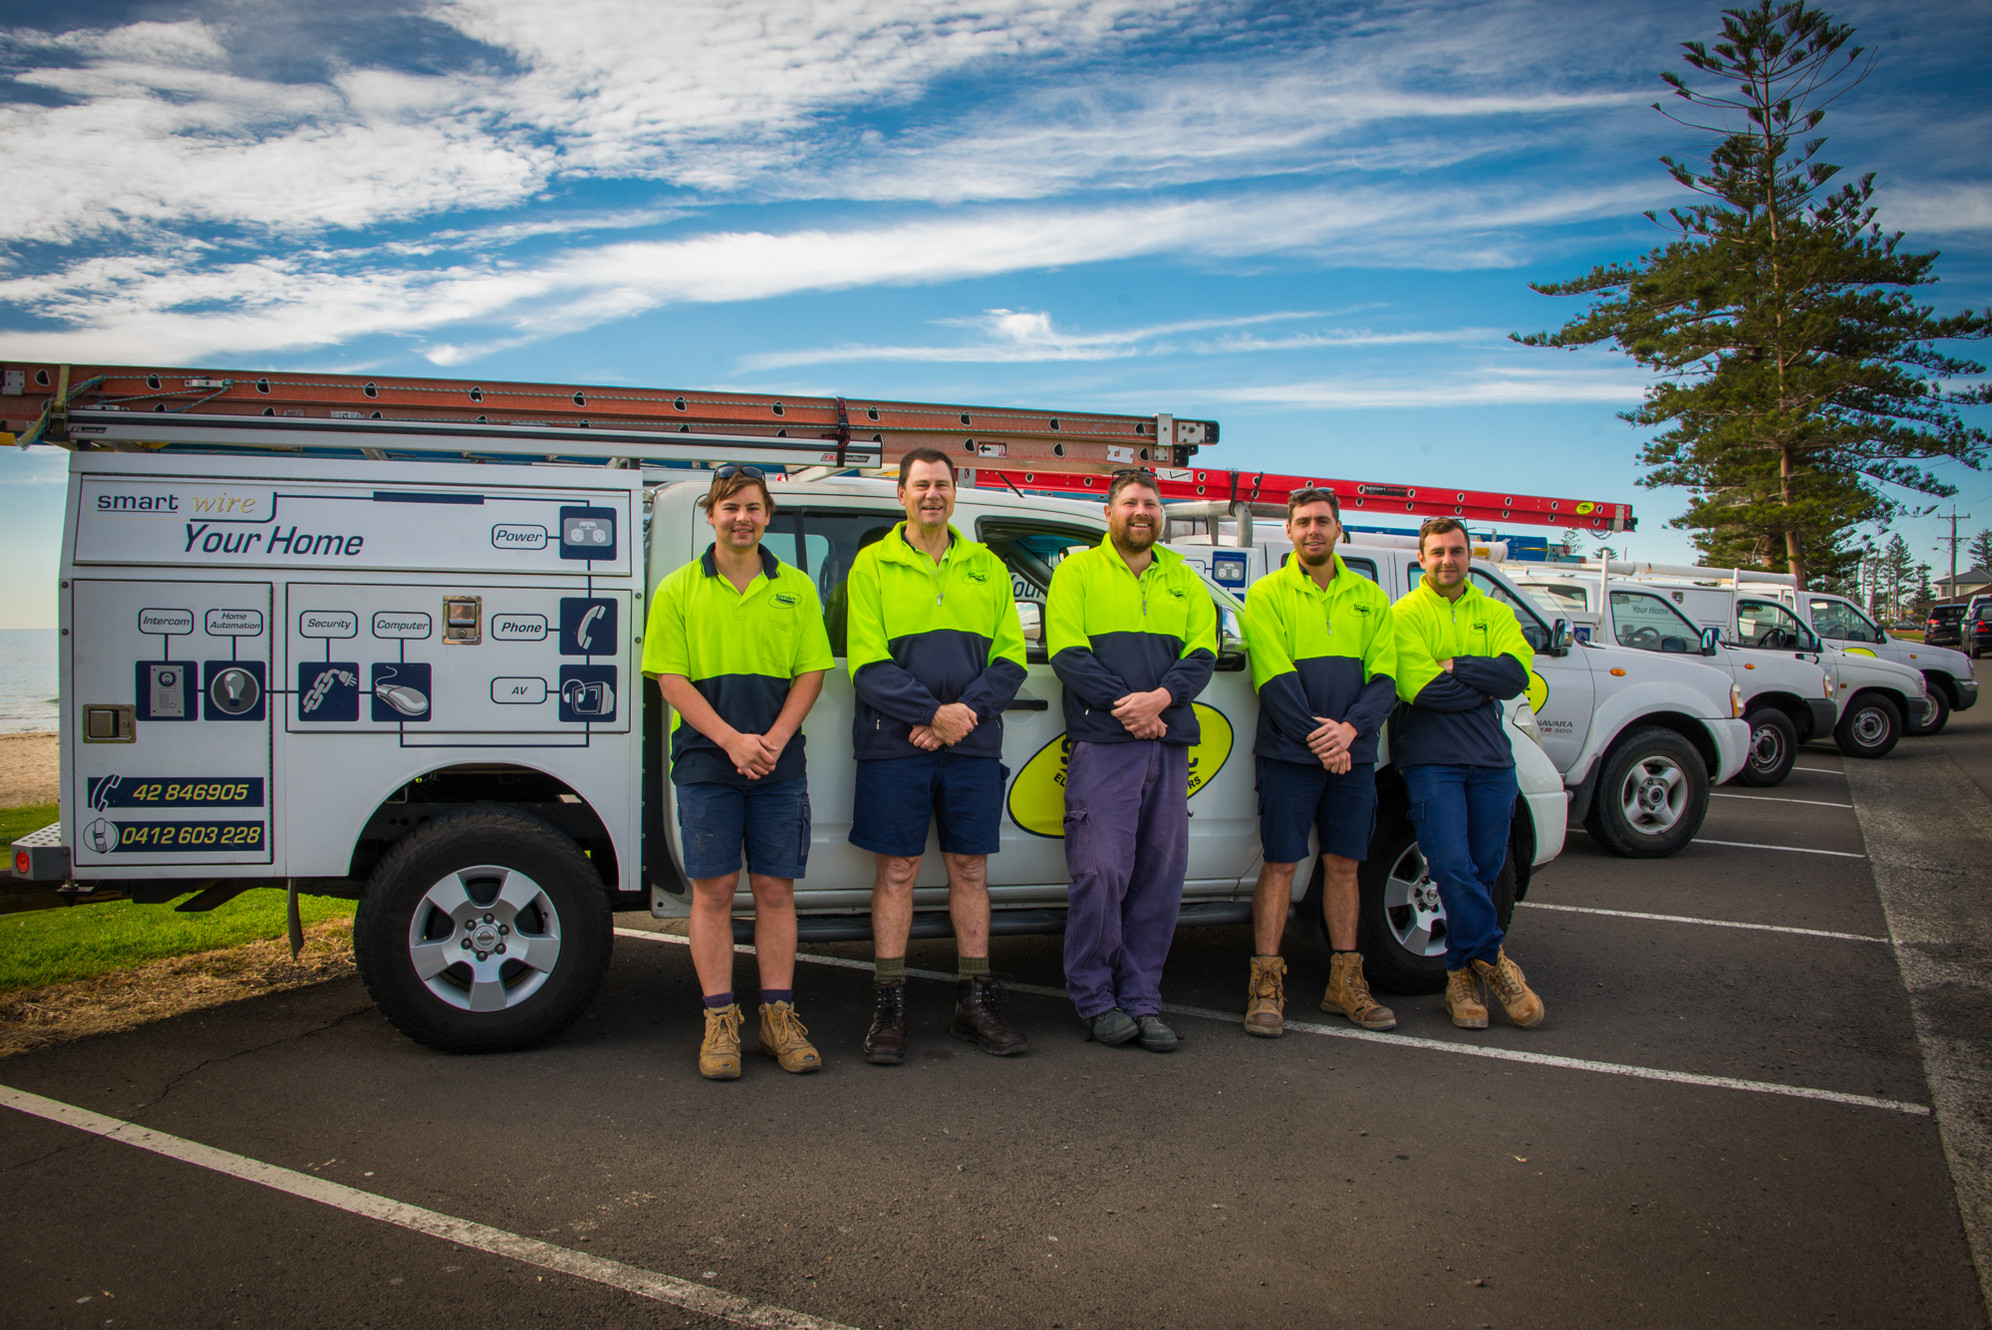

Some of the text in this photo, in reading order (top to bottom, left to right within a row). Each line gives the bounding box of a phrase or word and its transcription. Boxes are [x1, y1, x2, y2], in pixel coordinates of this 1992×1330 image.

[97, 491, 256, 513] smart wire
[185, 523, 364, 555] Your Home
[495, 529, 543, 542] Power
[221, 612, 247, 620] Home
[1633, 605, 1669, 615] Your Home
[142, 615, 190, 626] Intercom
[209, 620, 260, 630] Automation
[307, 618, 351, 631] Security
[377, 619, 428, 632] Computer
[501, 622, 542, 633] Phone
[511, 686, 528, 695] AV
[132, 784, 249, 800] 42 846905
[121, 827, 261, 844] 0412 603 228
